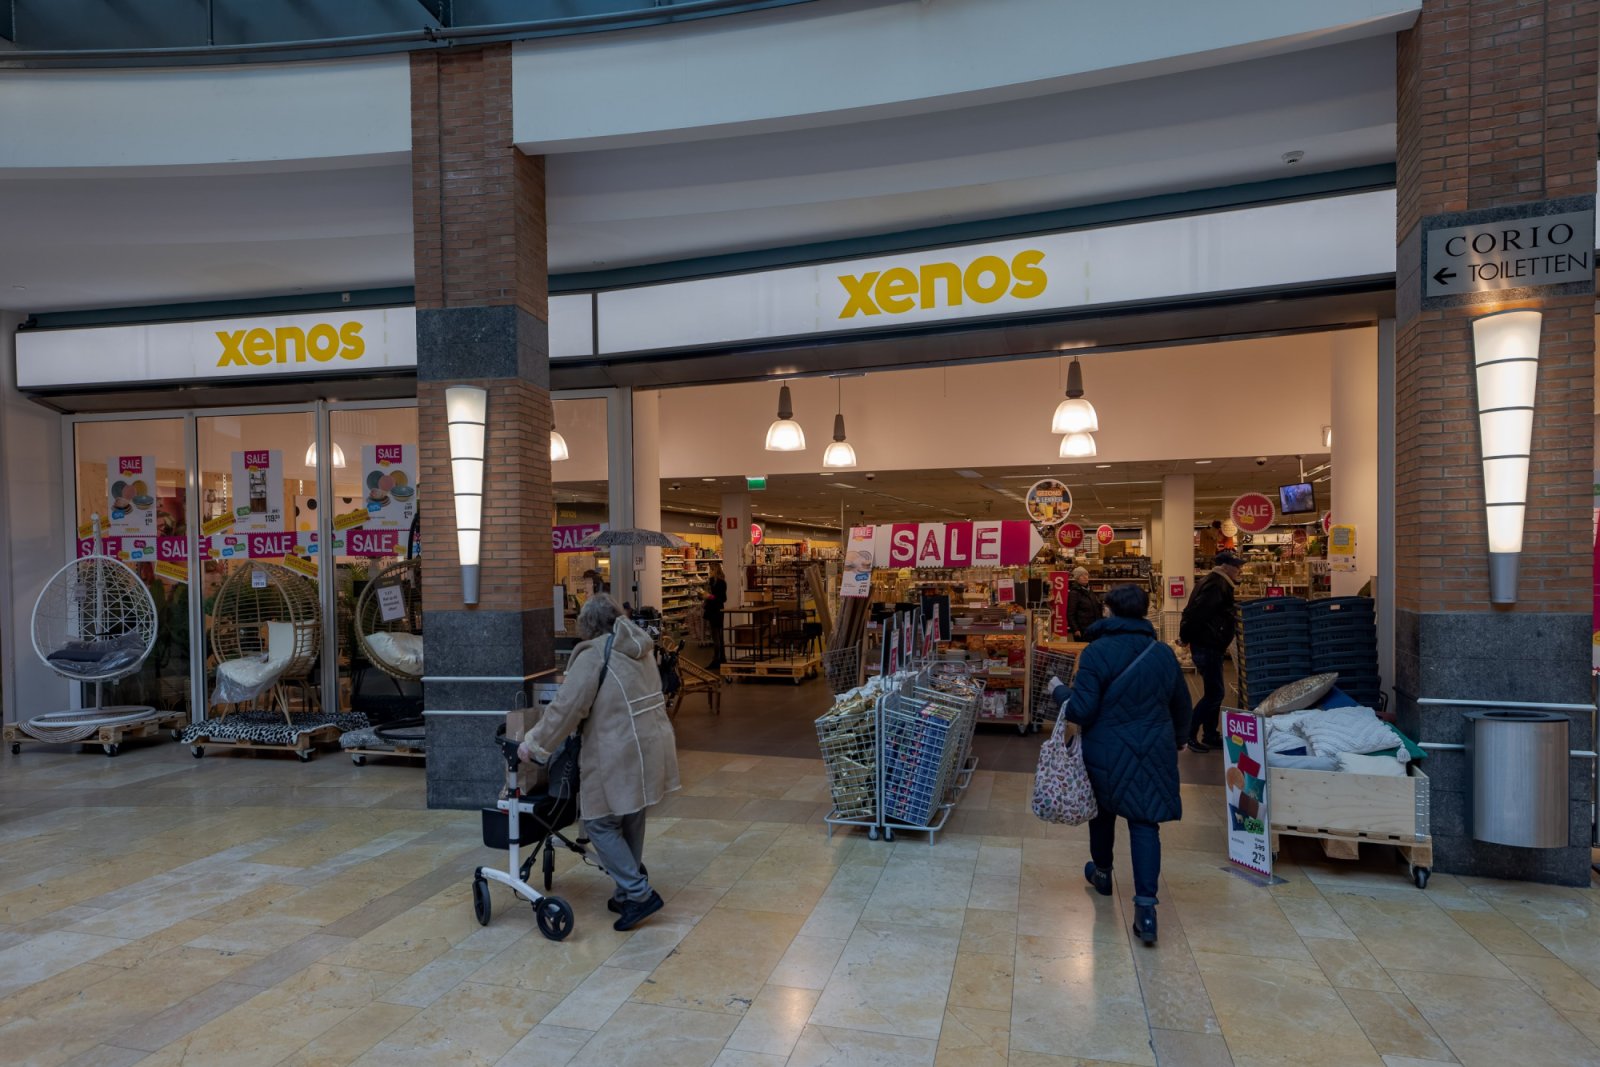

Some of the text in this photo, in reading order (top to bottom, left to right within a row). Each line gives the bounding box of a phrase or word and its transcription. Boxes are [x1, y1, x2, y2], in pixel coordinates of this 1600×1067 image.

[1445, 223, 1574, 257] CORIO
[1467, 252, 1588, 282] TOILETTEN
[837, 249, 1048, 319] xenos
[214, 321, 366, 368] xenos
[246, 454, 267, 464] SALE
[378, 448, 400, 459] SALE
[121, 460, 140, 469] SALE
[1237, 504, 1269, 517] SALE
[855, 527, 871, 537] SALE
[1060, 530, 1081, 539] SALE
[253, 536, 292, 554] SALE
[352, 534, 393, 553] SALE
[892, 527, 999, 561] SALE
[1053, 576, 1065, 633] SALE
[1229, 718, 1255, 737] SALE
